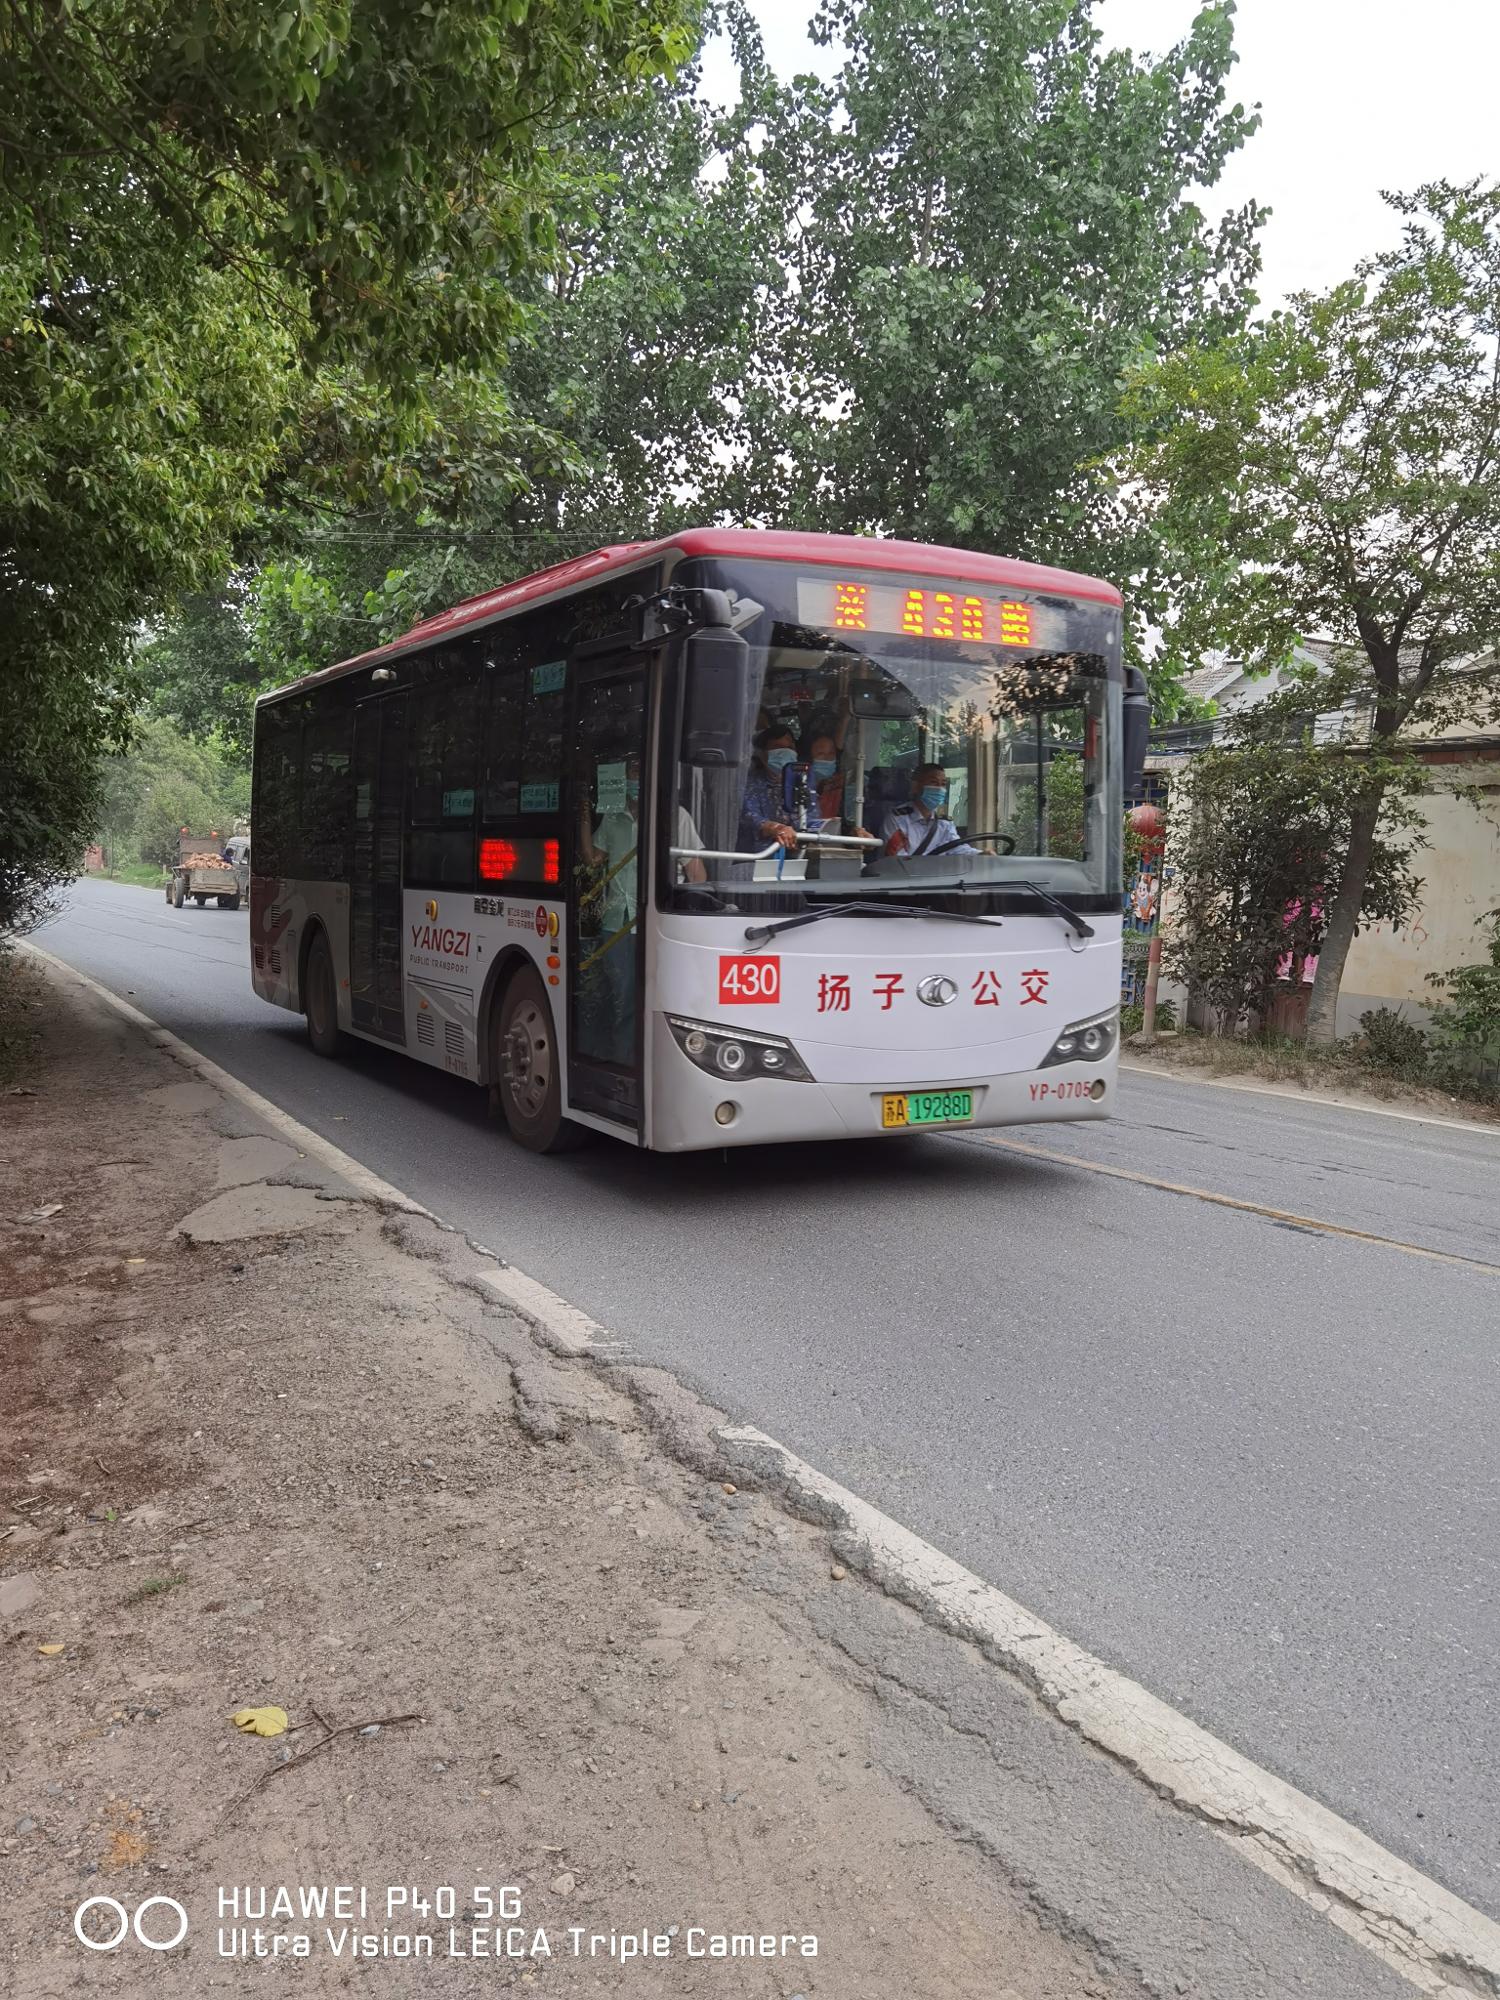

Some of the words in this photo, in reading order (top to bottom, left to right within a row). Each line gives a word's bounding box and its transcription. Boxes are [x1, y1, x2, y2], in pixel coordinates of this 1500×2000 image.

[411, 925, 471, 957] YANGZI
[431, 960, 469, 975] TRANSPORT
[722, 963, 778, 996] 430
[1029, 1081, 1091, 1101] YP-0705
